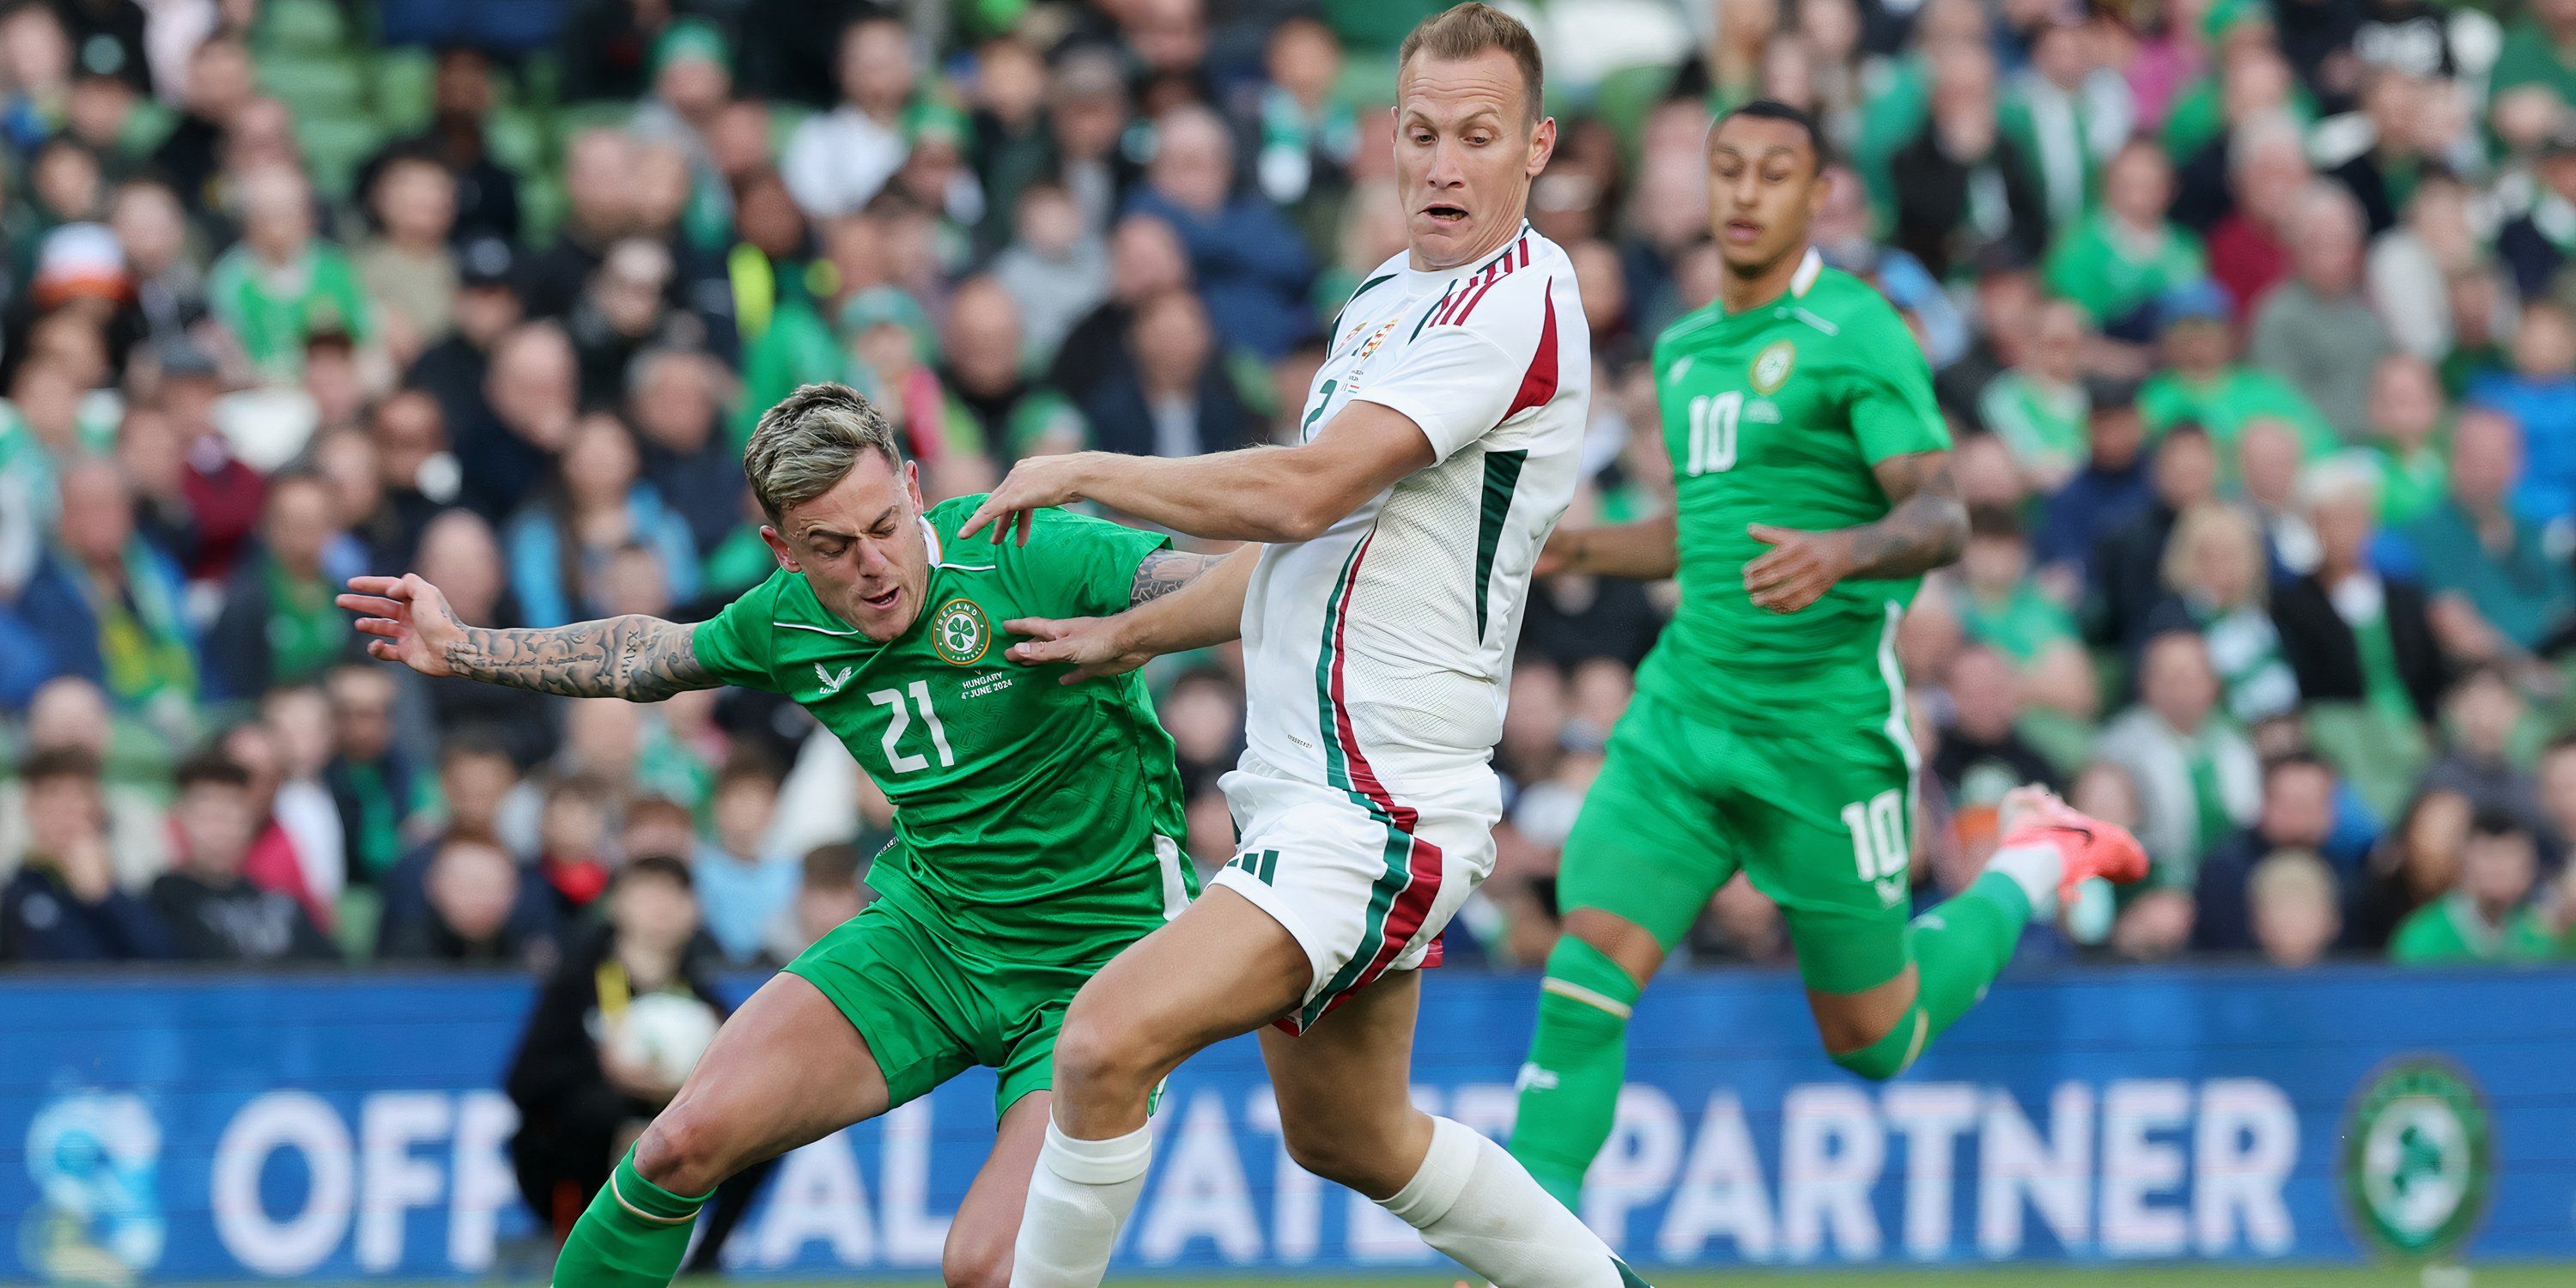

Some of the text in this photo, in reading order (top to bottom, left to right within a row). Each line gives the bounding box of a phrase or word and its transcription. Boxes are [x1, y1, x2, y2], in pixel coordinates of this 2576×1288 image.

[1686, 390, 1744, 477] 10
[935, 603, 978, 631] IRELAND
[962, 671, 1002, 689] HUNGARY
[970, 684, 992, 697] JUNE
[993, 679, 1012, 690] 2024
[866, 679, 954, 774] 21
[1841, 787, 1909, 882] 10
[211, 1087, 950, 1273] OFFAL
[1580, 1078, 2302, 1266] PARTNER
